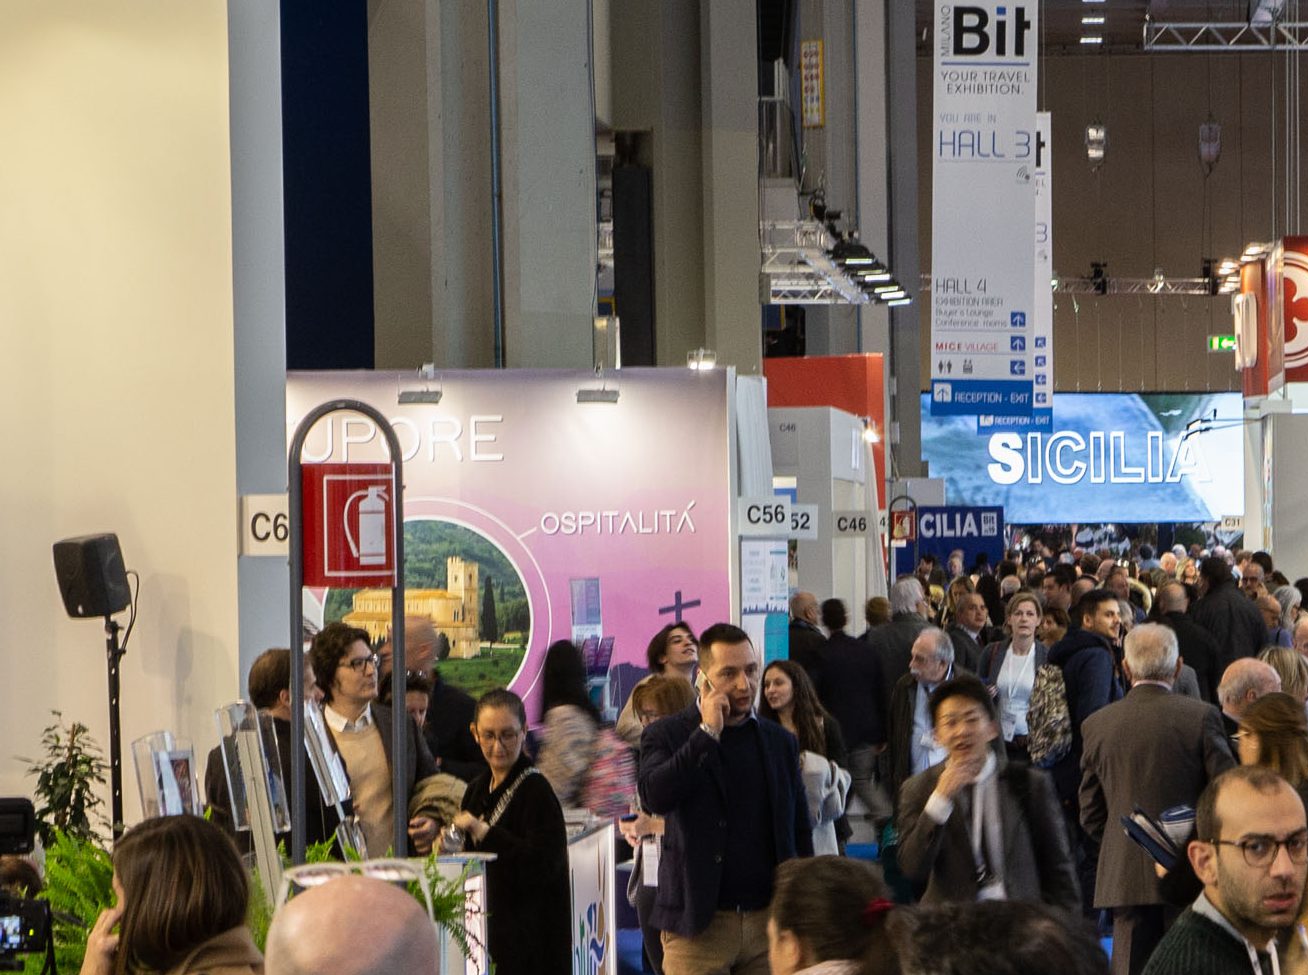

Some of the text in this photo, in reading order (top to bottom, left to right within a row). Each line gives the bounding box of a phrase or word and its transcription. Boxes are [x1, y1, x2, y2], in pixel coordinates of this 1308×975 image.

[953, 6, 1031, 57] Bit
[941, 71, 1030, 83] YOUR TRAVEL
[946, 83, 1024, 95] EXHIBITION.
[939, 129, 1005, 158] HALL
[1015, 130, 1031, 158] 3
[936, 277, 987, 295] HALL 4
[954, 391, 1003, 404] RECEPTION
[1010, 392, 1030, 404] EXIT
[994, 415, 1050, 426] RECEPTION EXIT
[987, 430, 1214, 485] SICILIA
[747, 504, 786, 524] C56
[837, 516, 867, 532] C46
[920, 512, 979, 539] CILIA
[1224, 519, 1241, 528] C31
